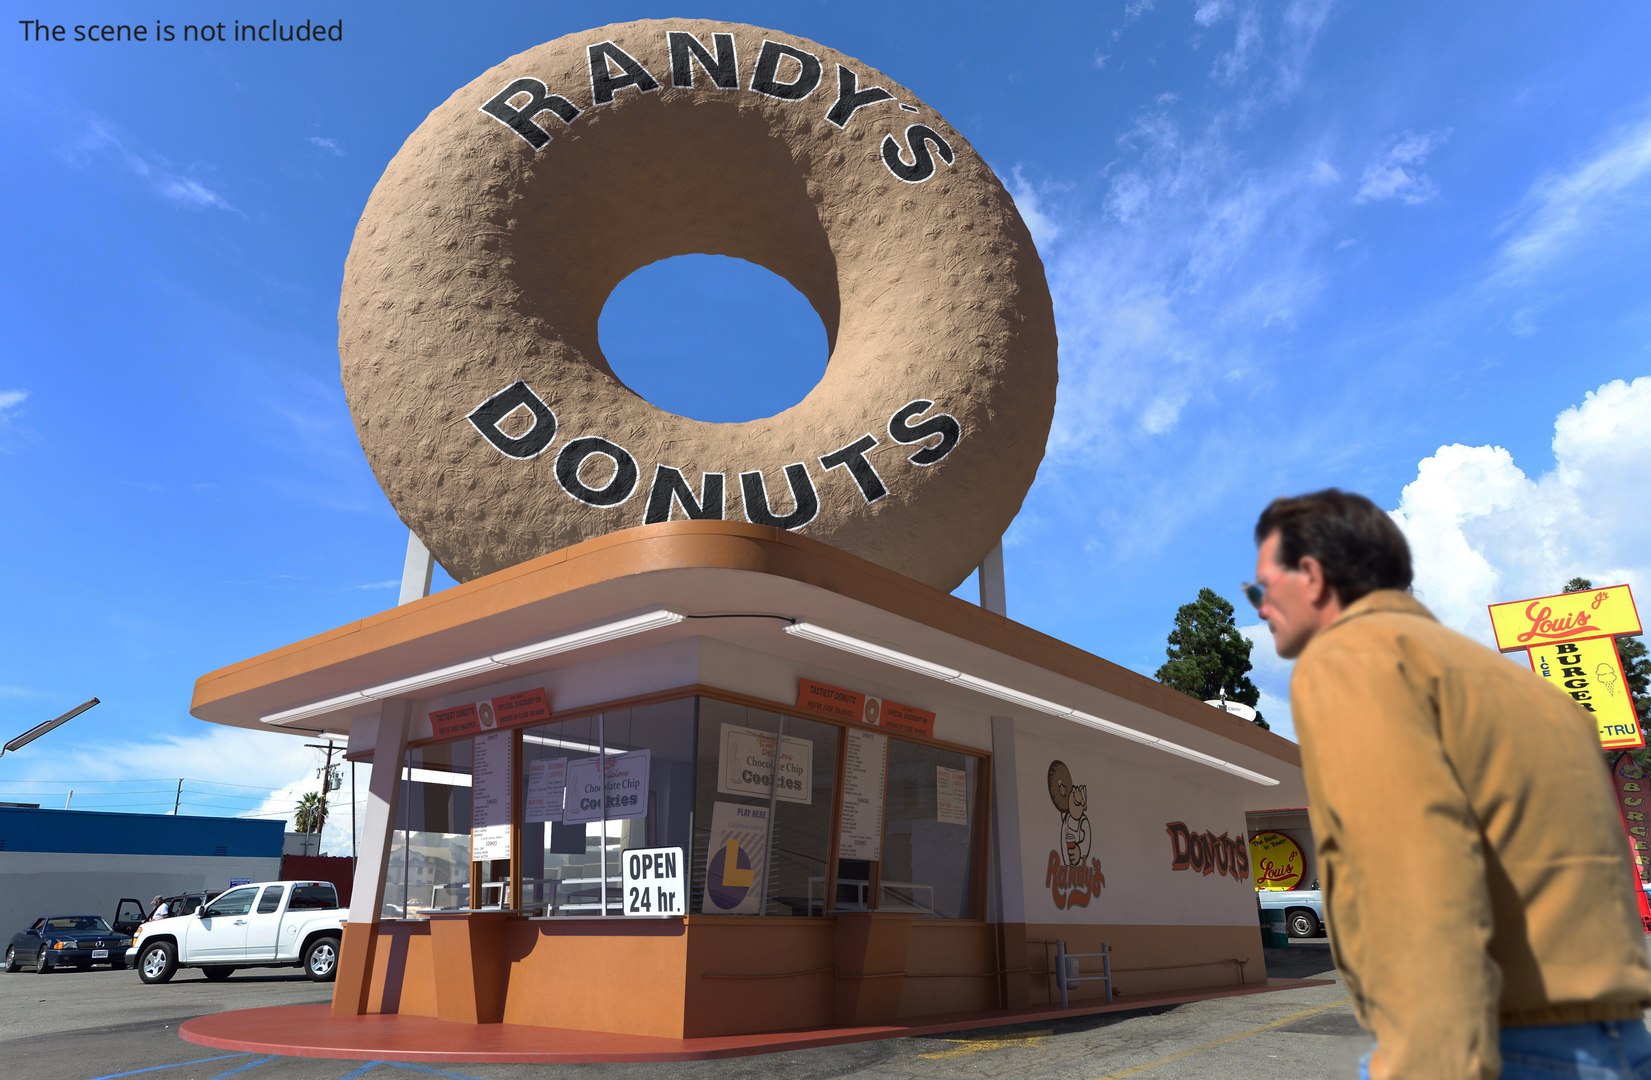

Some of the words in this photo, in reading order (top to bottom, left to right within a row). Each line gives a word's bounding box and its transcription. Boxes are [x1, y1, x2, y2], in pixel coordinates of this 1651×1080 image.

[478, 30, 955, 185] RANDY'S
[465, 380, 961, 531] DONUTS
[1517, 601, 1601, 643] Louis
[1540, 655, 1552, 678] ICE
[834, 691, 857, 704] DONUTS
[746, 755, 785, 770] Chocole
[786, 762, 804, 777] Chip
[584, 780, 621, 794] Choclate
[621, 777, 640, 791] Chip
[736, 807, 751, 817] PLAY
[751, 809, 768, 819] HERE
[1252, 840, 1264, 848] The
[629, 851, 677, 881] OPEN
[1256, 857, 1299, 885] Louis
[629, 886, 652, 913] 24
[657, 886, 681, 912] hr.
